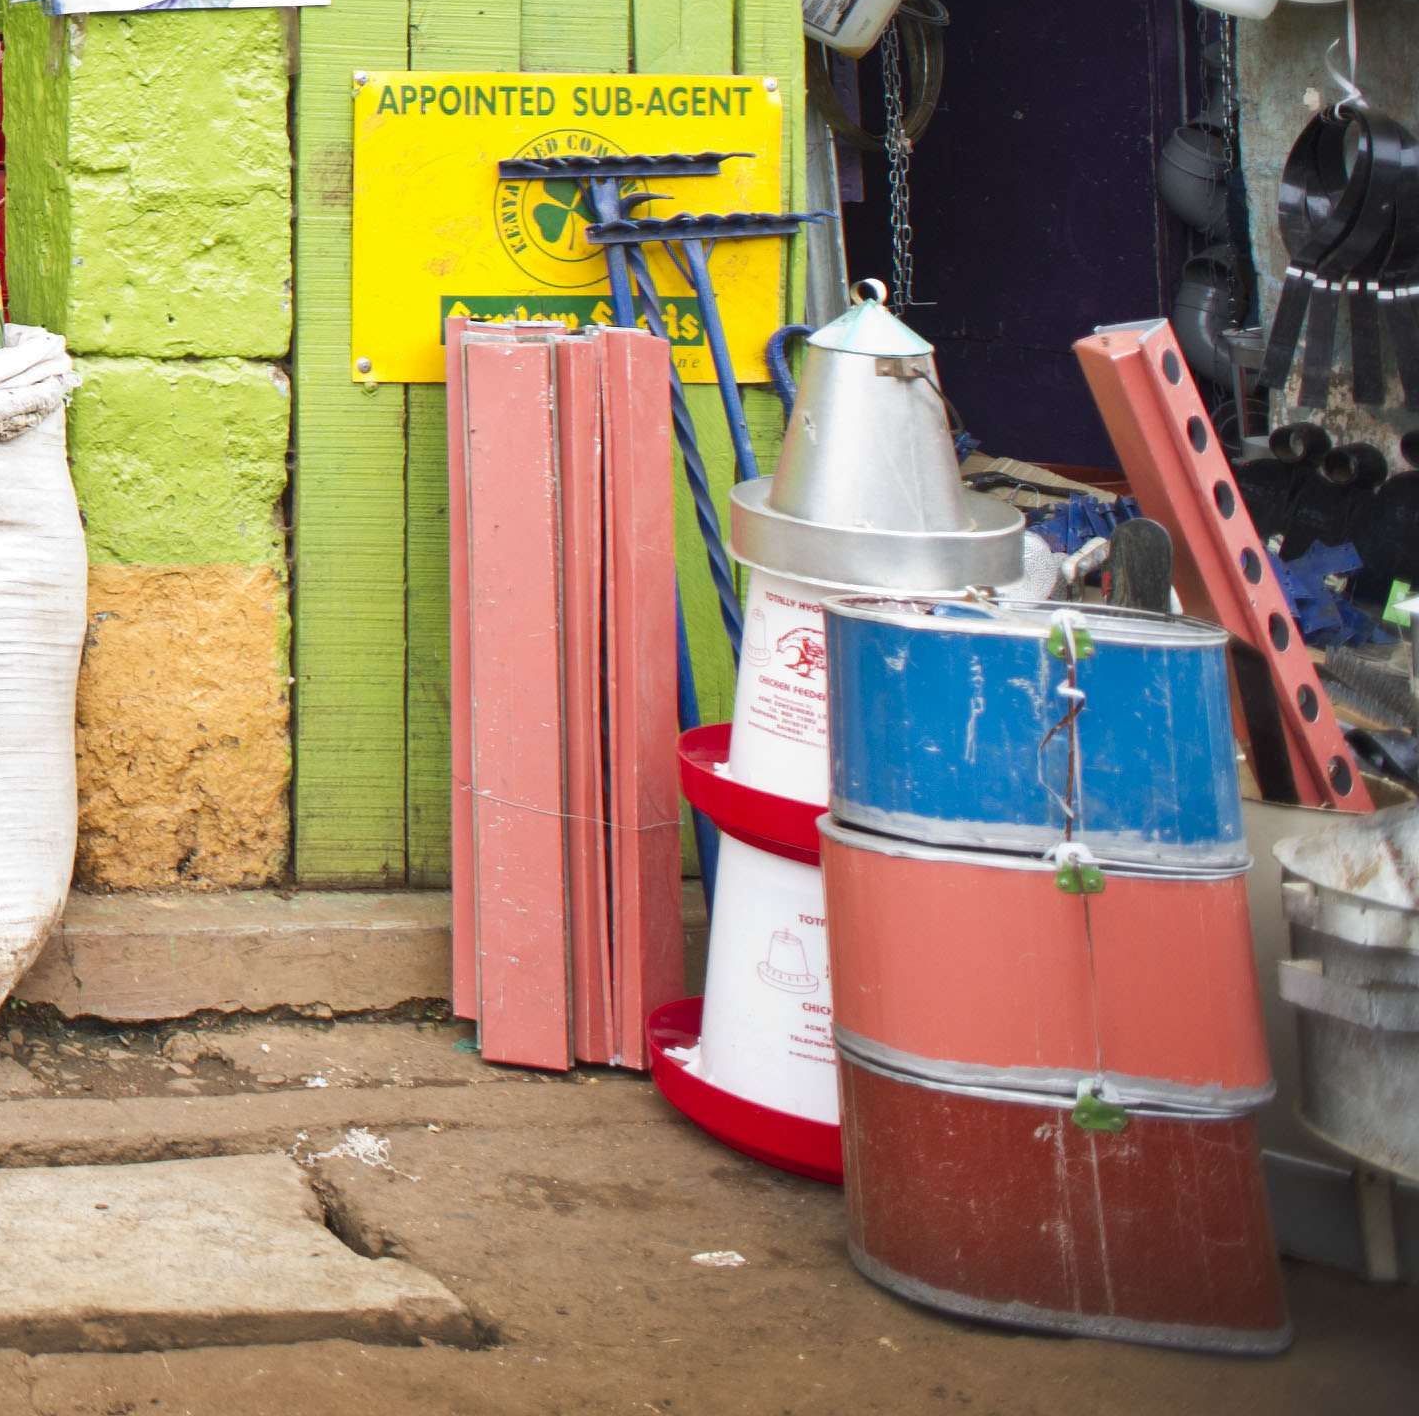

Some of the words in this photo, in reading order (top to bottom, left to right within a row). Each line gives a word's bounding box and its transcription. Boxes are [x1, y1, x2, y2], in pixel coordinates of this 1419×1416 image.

[377, 85, 555, 116] APPOINTED
[573, 86, 752, 116] SUB-AGENT
[501, 184, 528, 255] KENYA
[765, 591, 796, 608] TOTALLY
[759, 675, 790, 691] CHICKEN
